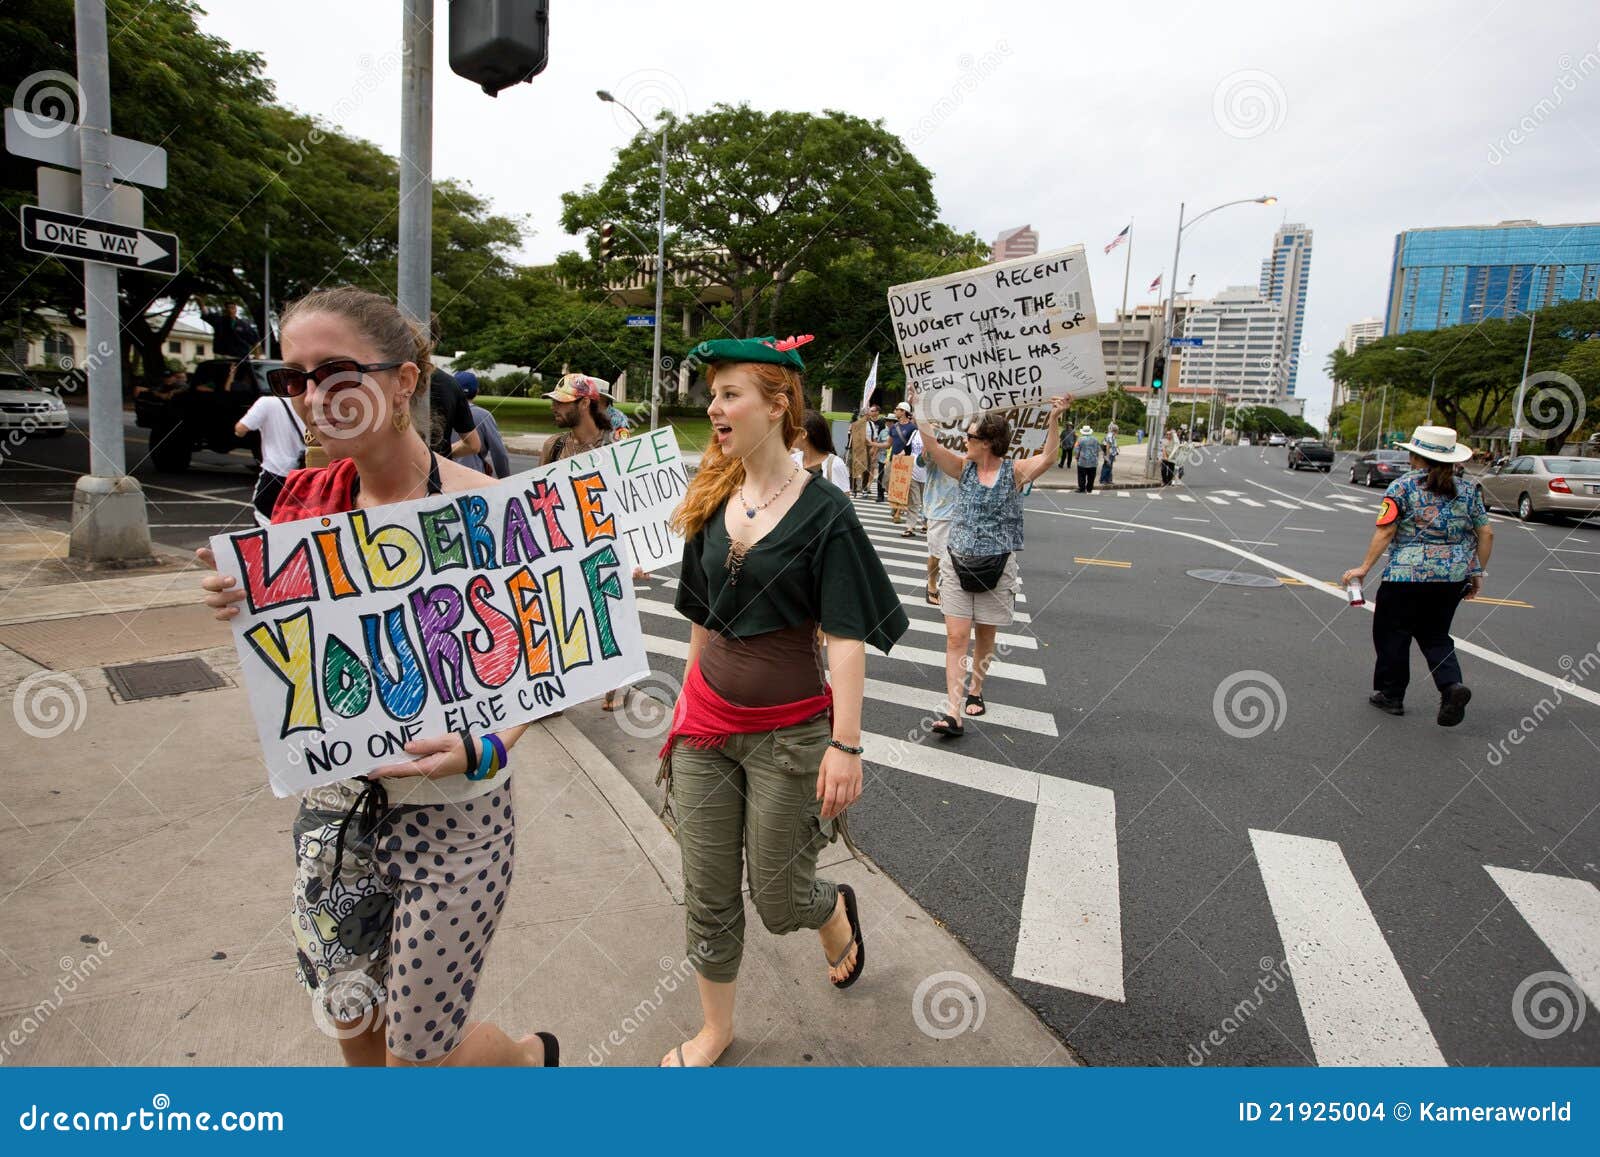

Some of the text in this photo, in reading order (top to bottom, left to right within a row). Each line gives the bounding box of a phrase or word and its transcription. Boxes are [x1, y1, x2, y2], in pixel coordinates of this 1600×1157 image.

[44, 223, 137, 255] ONE WAY
[890, 259, 1073, 317] DUE TO RECENT
[897, 292, 1056, 340] BUDGET CUTS, THE
[902, 312, 1085, 359] LIGHT at the end of
[905, 342, 1061, 378] THE TUNNEL HAS
[913, 365, 1042, 395] BEEN TURNED
[979, 386, 1043, 410] OFF!!!
[304, 676, 566, 775] NO ONE ELSE CAN
